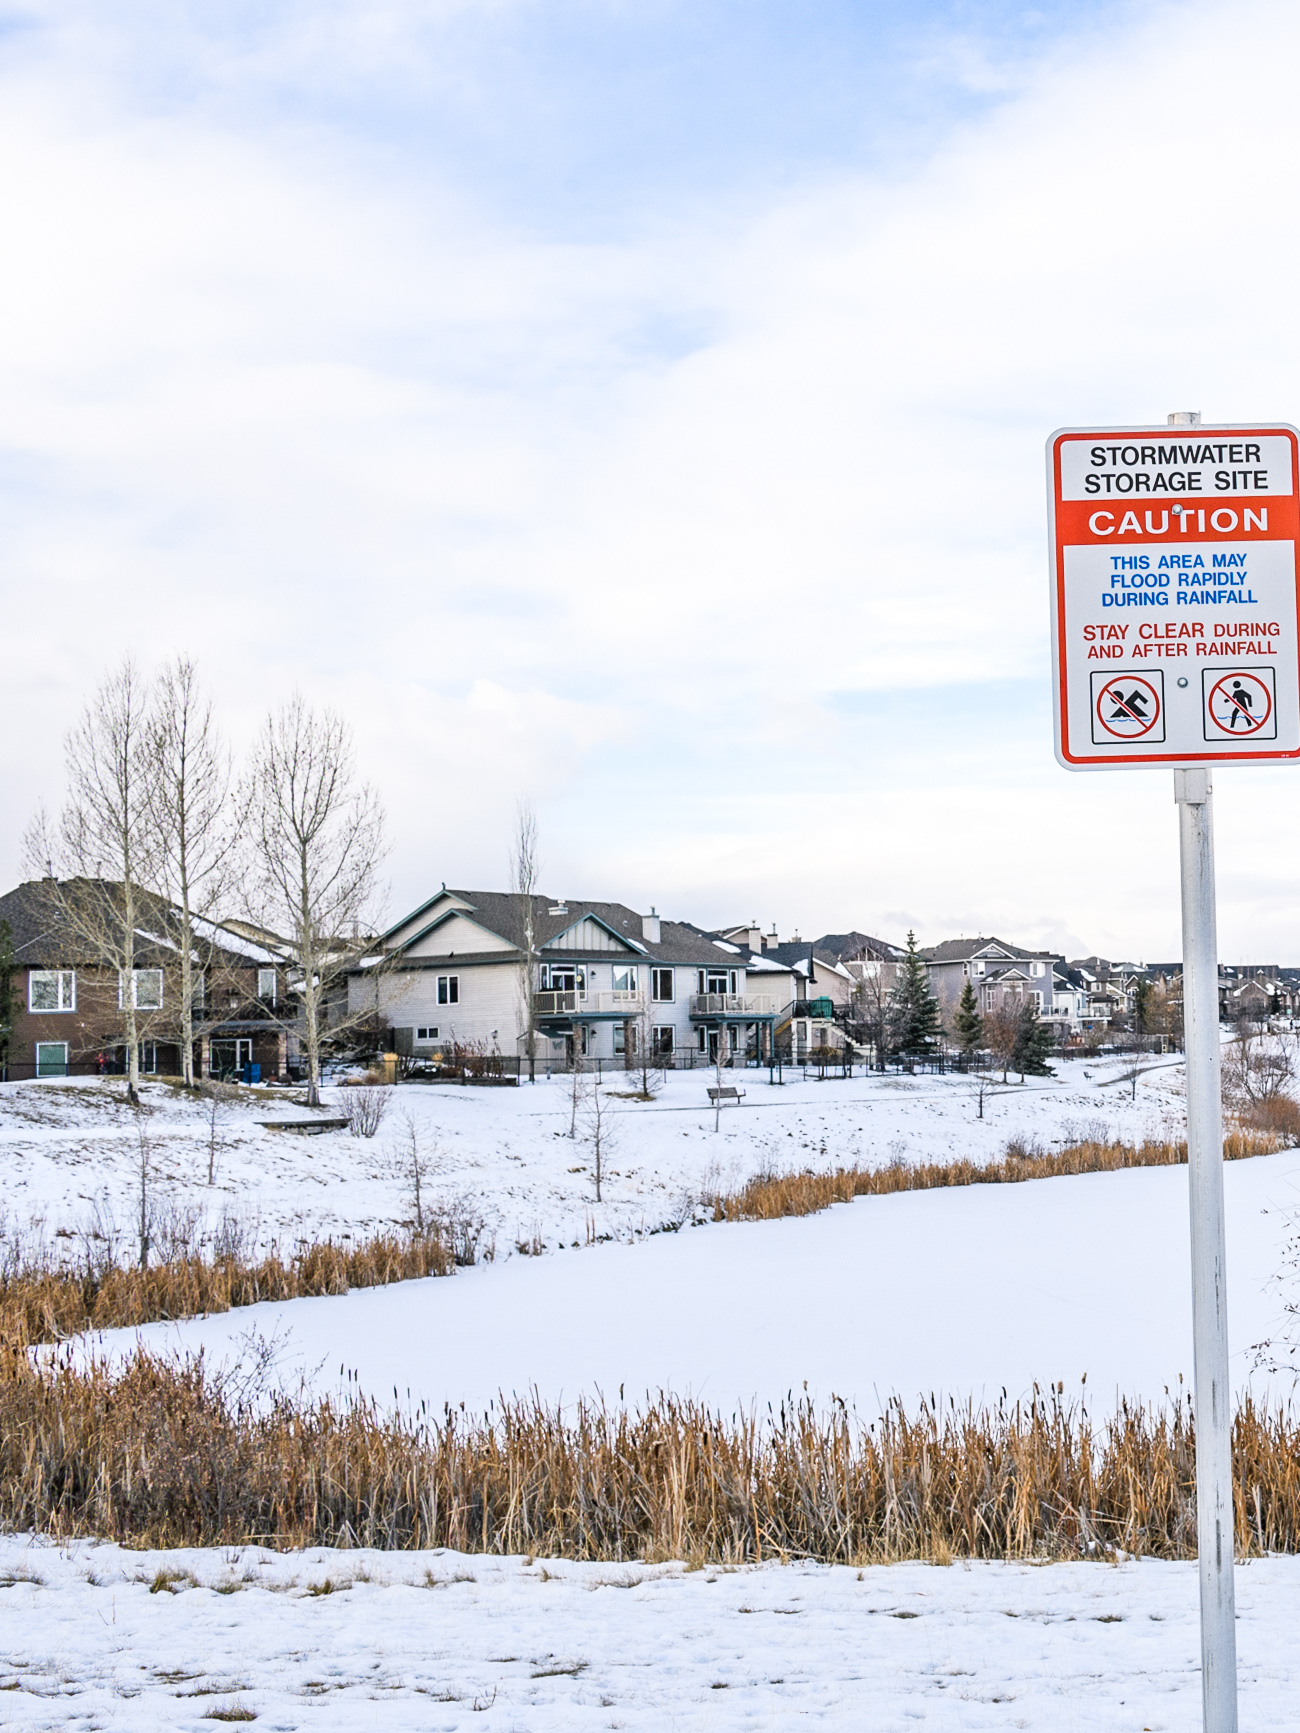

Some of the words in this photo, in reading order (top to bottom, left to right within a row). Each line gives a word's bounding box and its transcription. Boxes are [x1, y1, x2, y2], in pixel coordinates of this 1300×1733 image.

[1090, 444, 1261, 466] STORMWATER
[1085, 472, 1202, 494] STORAGE
[1215, 470, 1268, 490] SITE
[1088, 507, 1268, 536] CAUTION
[1111, 556, 1150, 570] THIS
[1158, 555, 1204, 568] AREA
[1212, 553, 1247, 567] MAY
[1111, 574, 1170, 588] FLOOD
[1178, 572, 1248, 586] RAPIDLY
[1102, 591, 1169, 607] DURING
[1177, 590, 1258, 604] RAINFALL
[1083, 624, 1129, 641] STAY
[1139, 623, 1204, 639] CLEAR
[1214, 623, 1280, 637] DURING
[1088, 645, 1124, 658] AND
[1132, 643, 1188, 657] AFTER
[1196, 641, 1277, 655] RAINFALL
